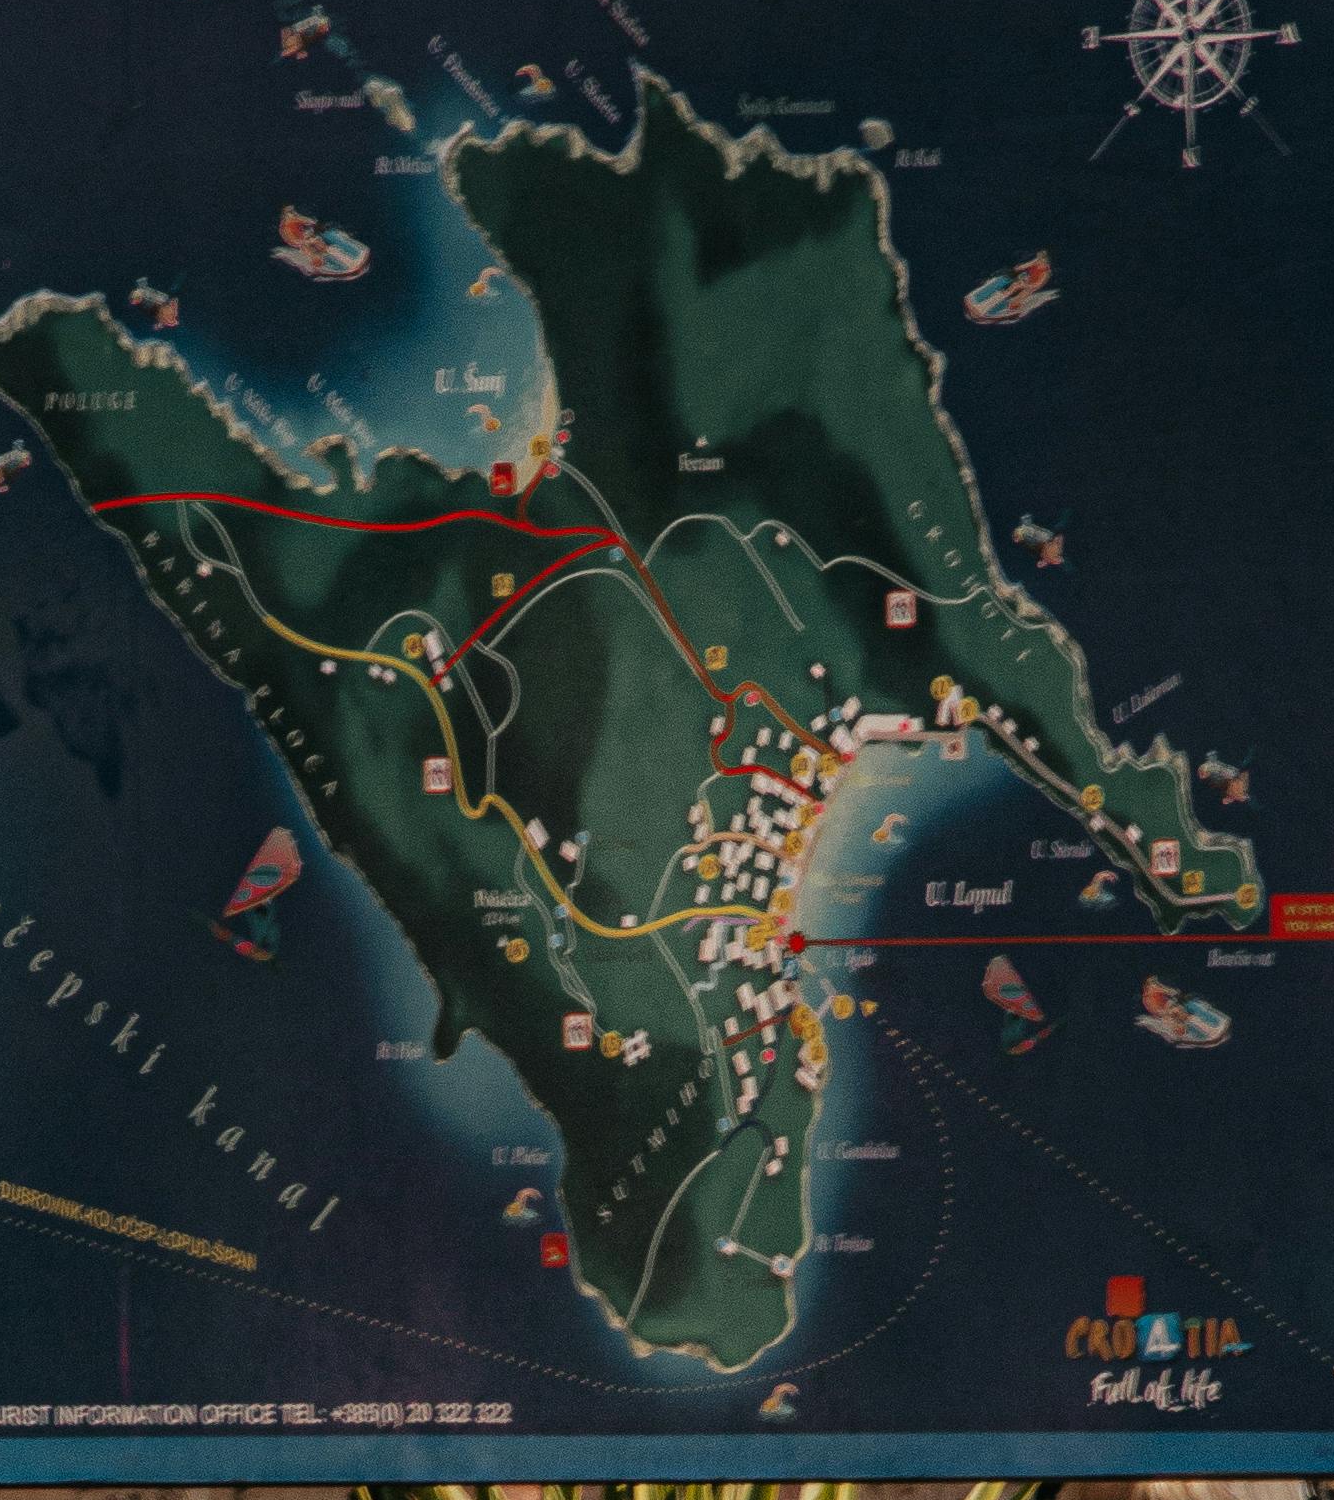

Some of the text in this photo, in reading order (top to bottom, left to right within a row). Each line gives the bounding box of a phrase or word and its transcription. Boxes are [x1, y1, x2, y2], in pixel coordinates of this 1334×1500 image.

[54, 1404, 199, 1426] INFORMATION
[200, 1404, 279, 1426] OFFICE
[281, 1403, 325, 1425] TEL:
[406, 1403, 431, 1425] 20
[434, 1403, 472, 1425] 322
[476, 1402, 513, 1425] 322
